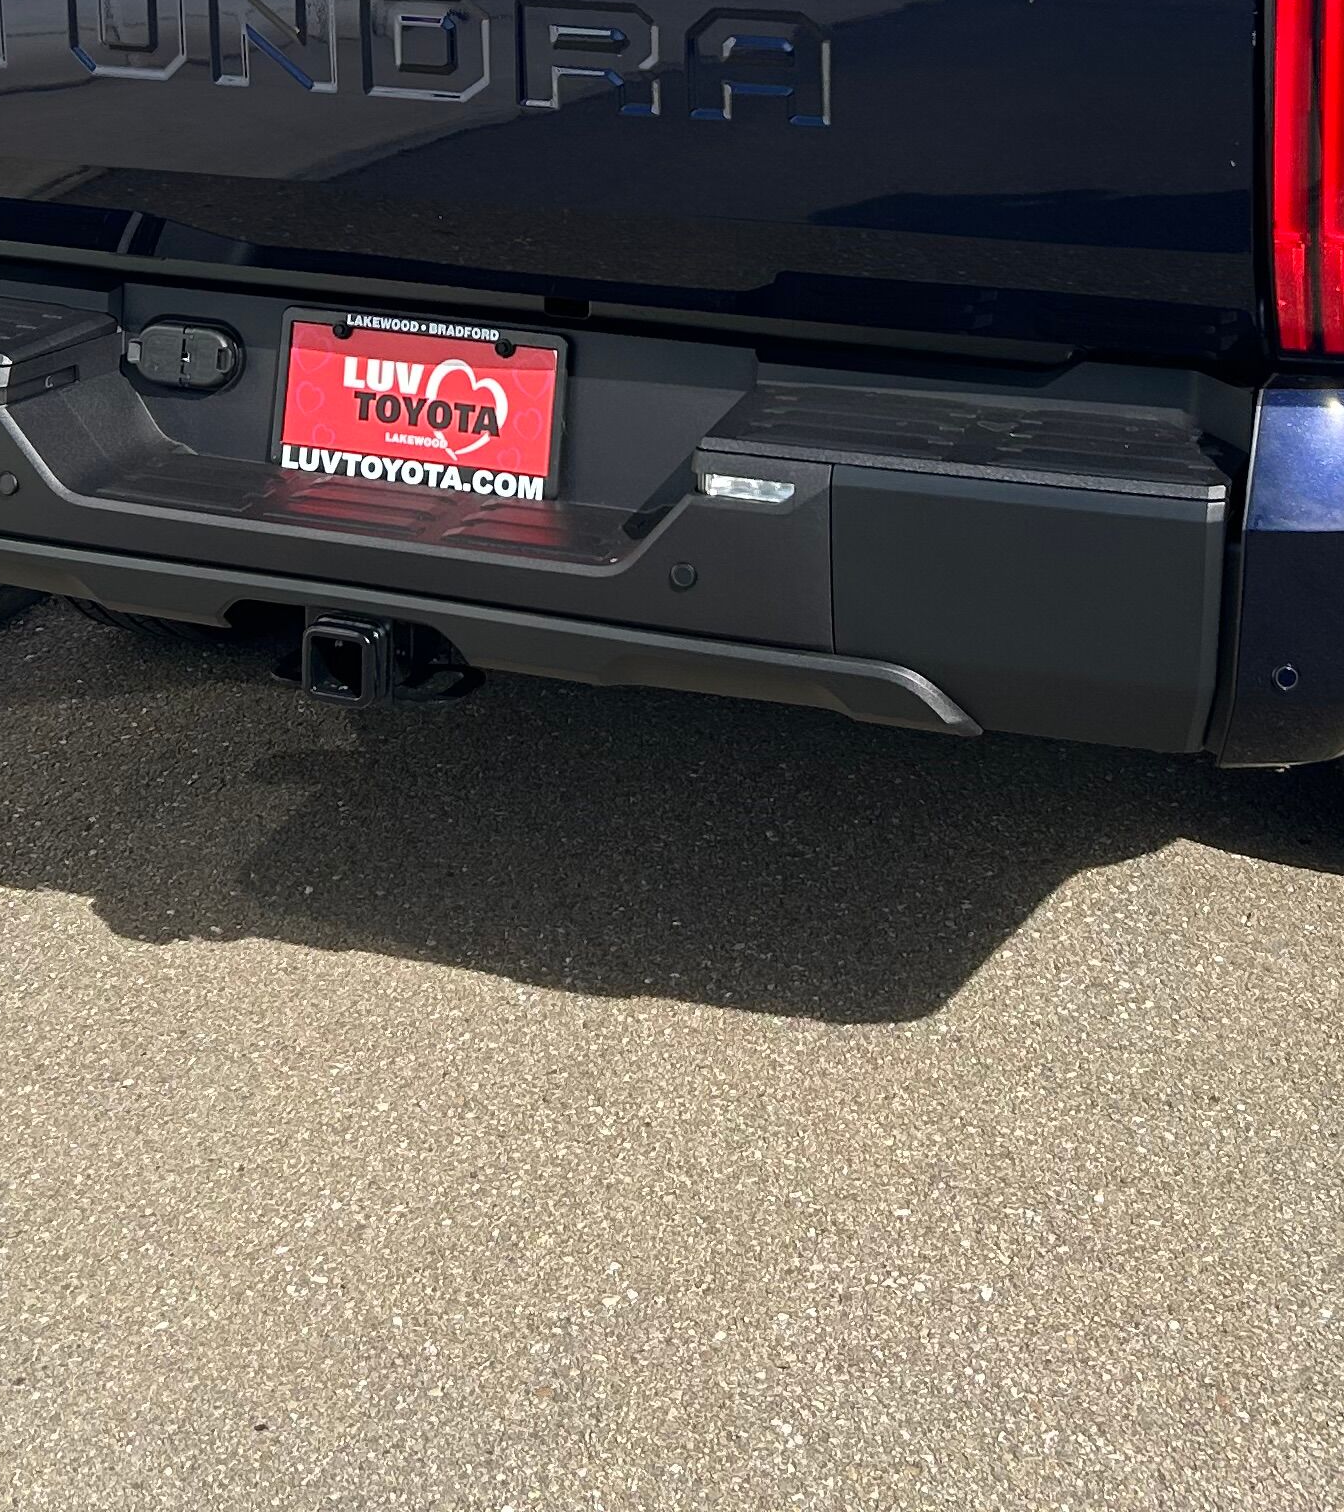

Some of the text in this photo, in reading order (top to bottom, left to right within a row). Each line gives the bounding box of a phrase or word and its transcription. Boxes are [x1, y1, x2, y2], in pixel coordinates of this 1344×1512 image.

[346, 314, 500, 341] LAKEWOOD BRADFORD
[343, 356, 425, 395] LUV
[354, 391, 500, 437] TOYOTA
[385, 431, 449, 449] LAKEWOOD
[281, 444, 544, 501] LUVTOYOTA.COM
